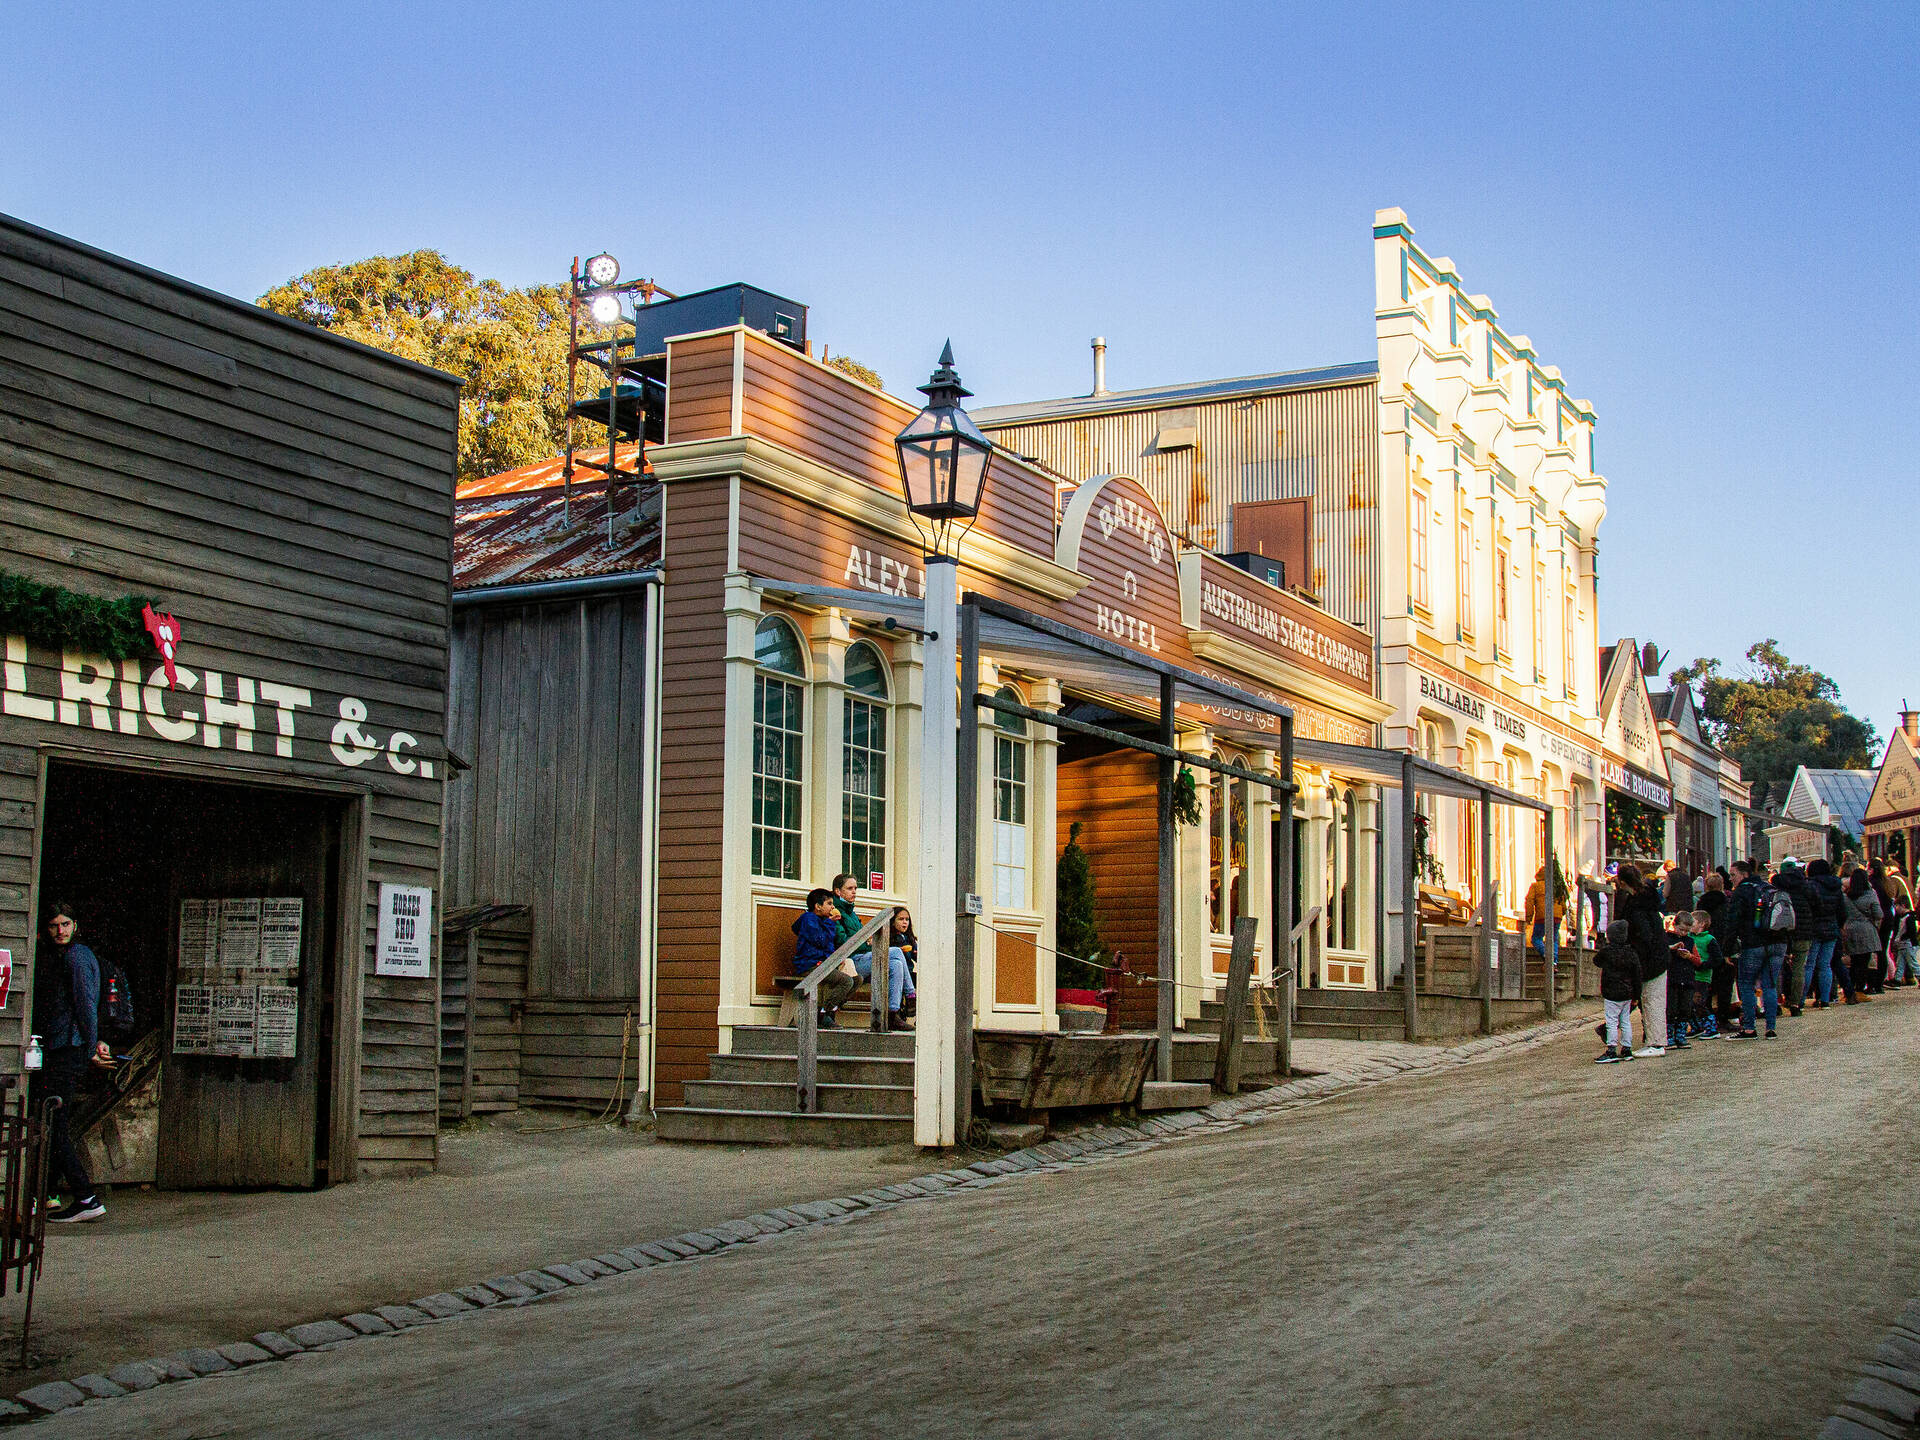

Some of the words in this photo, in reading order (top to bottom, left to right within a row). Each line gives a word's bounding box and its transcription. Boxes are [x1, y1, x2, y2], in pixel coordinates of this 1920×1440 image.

[1099, 498, 1164, 564] BATH'S
[844, 545, 909, 598] ALEX
[1097, 604, 1160, 652] HOTEL
[1203, 581, 1279, 642] AUSTRALIAN
[1280, 616, 1315, 658] STAGE
[1282, 700, 1326, 741] OACH
[1328, 718, 1368, 746] OFFICE
[1420, 675, 1486, 722] BALLARAT
[1493, 709, 1526, 740] TIMES
[1551, 738, 1593, 770] SPENCER
[1623, 727, 1646, 752] GROCERS
[1632, 774, 1670, 808] BROTHERS
[393, 893, 421, 916] HORSES
[395, 918, 416, 940] SHOD
[179, 989, 210, 997] WRESTLING
[179, 997, 210, 1005] WRESTLING
[178, 1006, 210, 1014] WRESTLING
